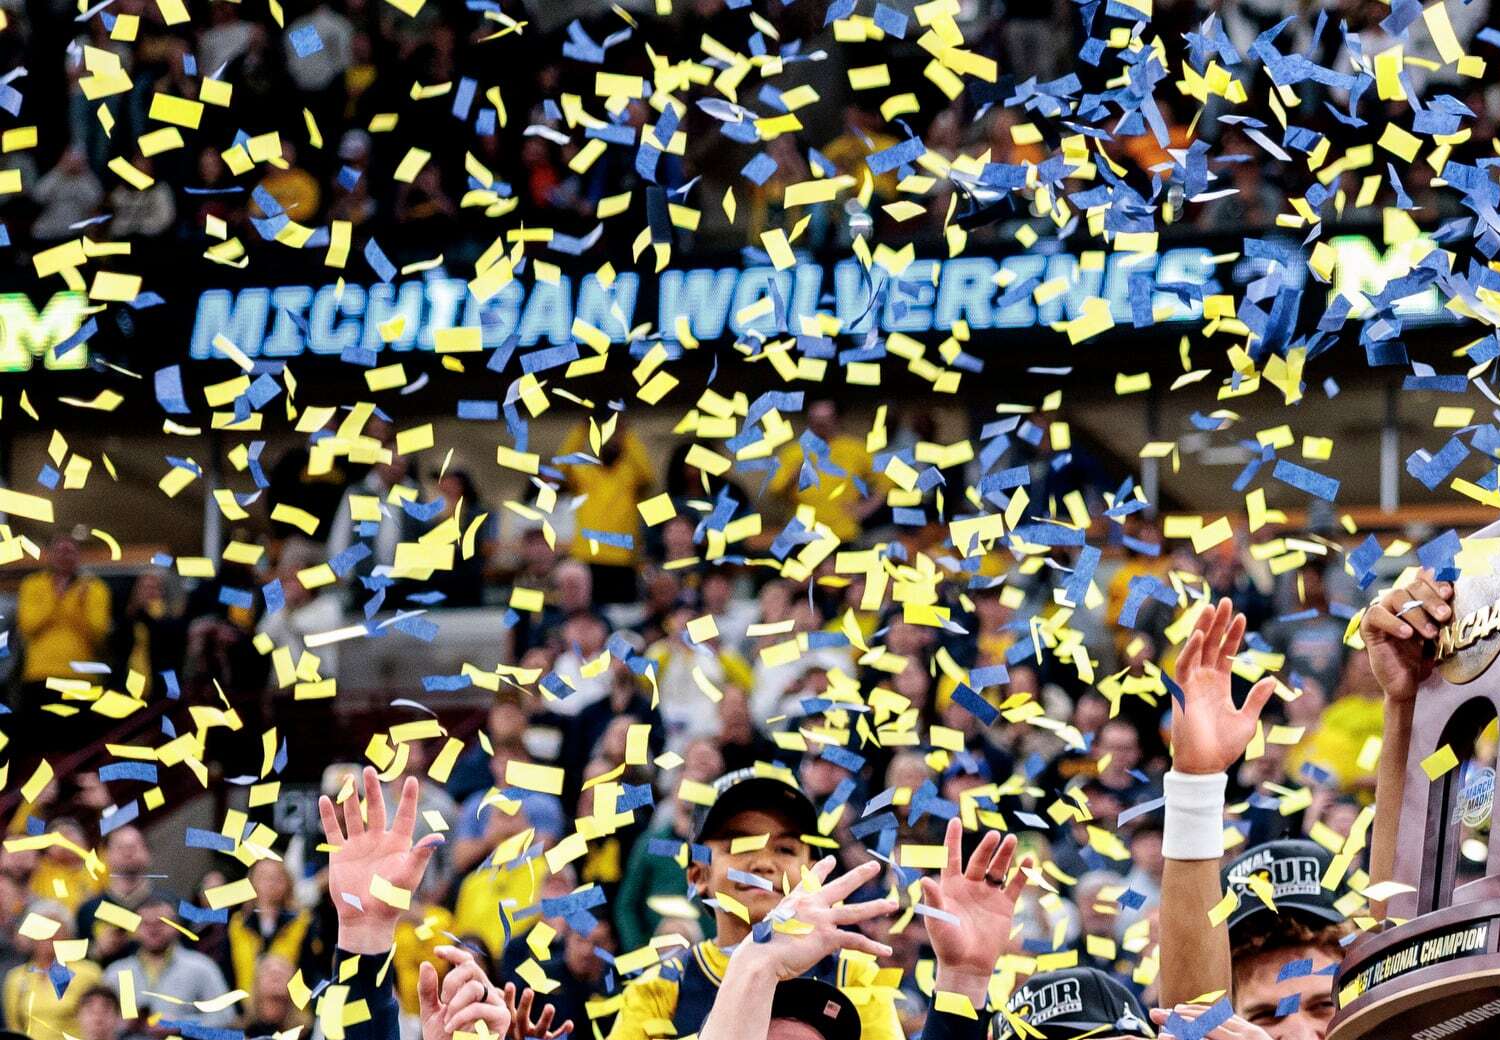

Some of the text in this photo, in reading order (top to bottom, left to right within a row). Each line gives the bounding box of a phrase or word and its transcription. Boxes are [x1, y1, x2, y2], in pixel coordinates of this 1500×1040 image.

[190, 247, 1217, 359] MICHIGAN WOLVERINES
[1373, 947, 1418, 986] REGIONAL
[1419, 926, 1488, 962] CHAMPION
